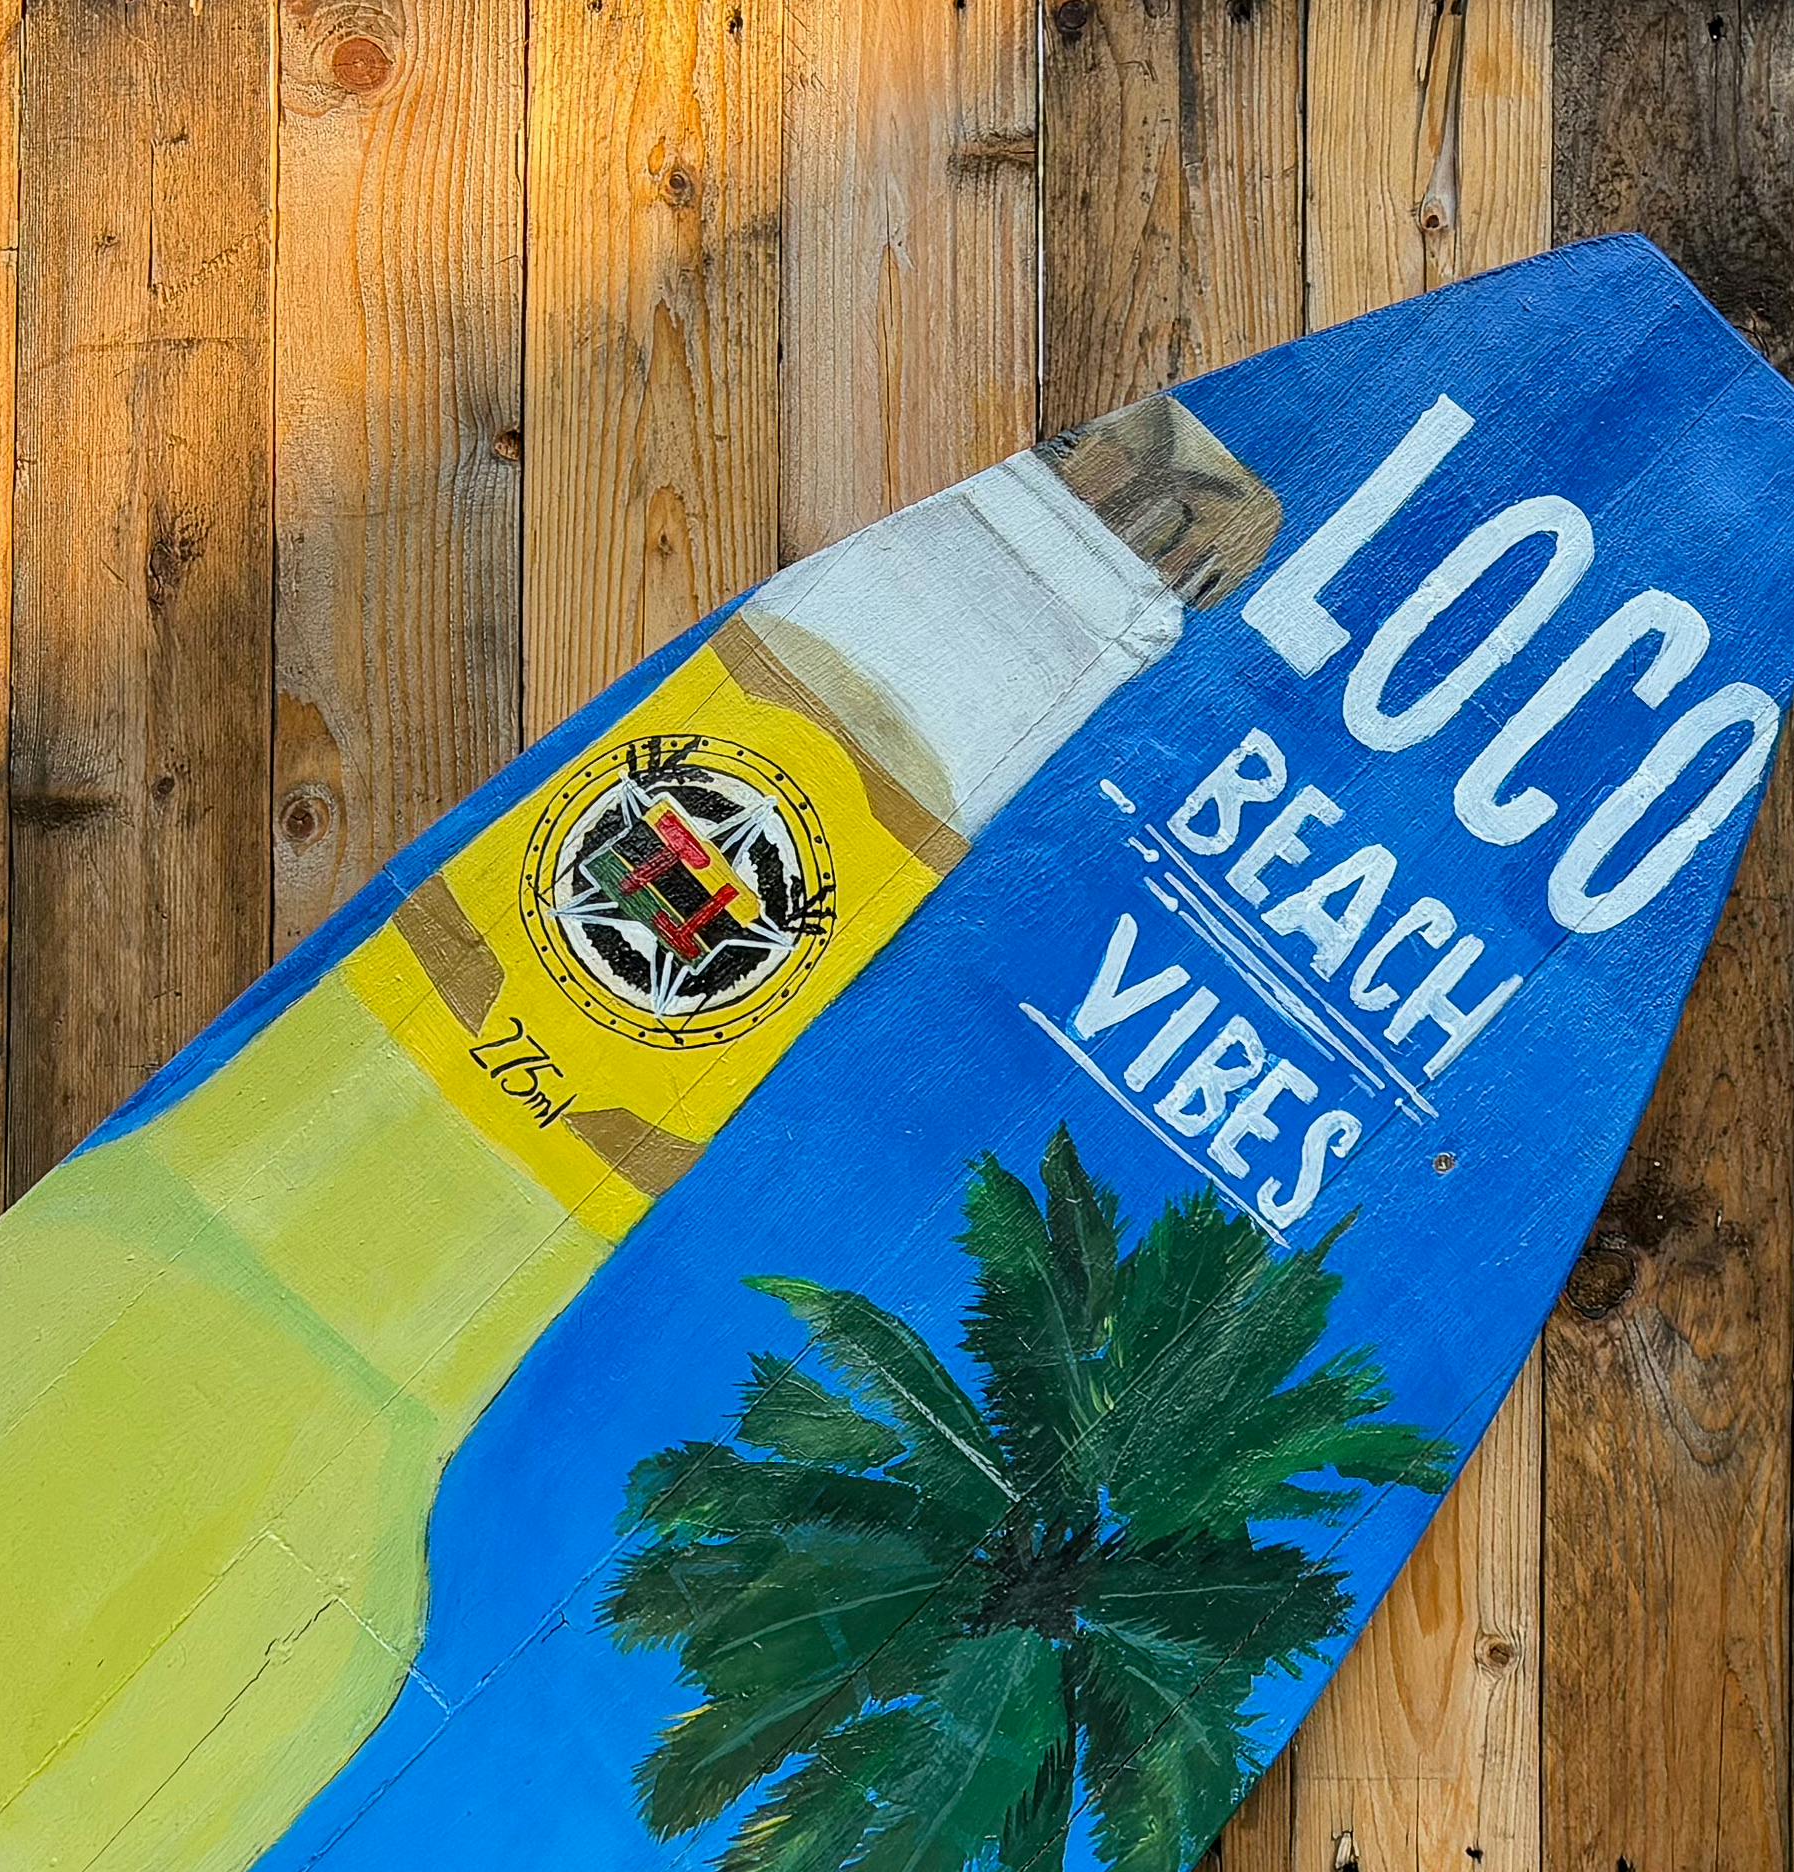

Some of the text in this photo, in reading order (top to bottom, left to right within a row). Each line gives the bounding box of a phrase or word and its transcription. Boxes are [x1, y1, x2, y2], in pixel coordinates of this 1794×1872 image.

[1242, 393, 1782, 935] LOCO
[1066, 911, 1363, 1230] VIBES
[1167, 726, 1524, 1081] BEACH
[468, 1016, 579, 1130] 275ml
